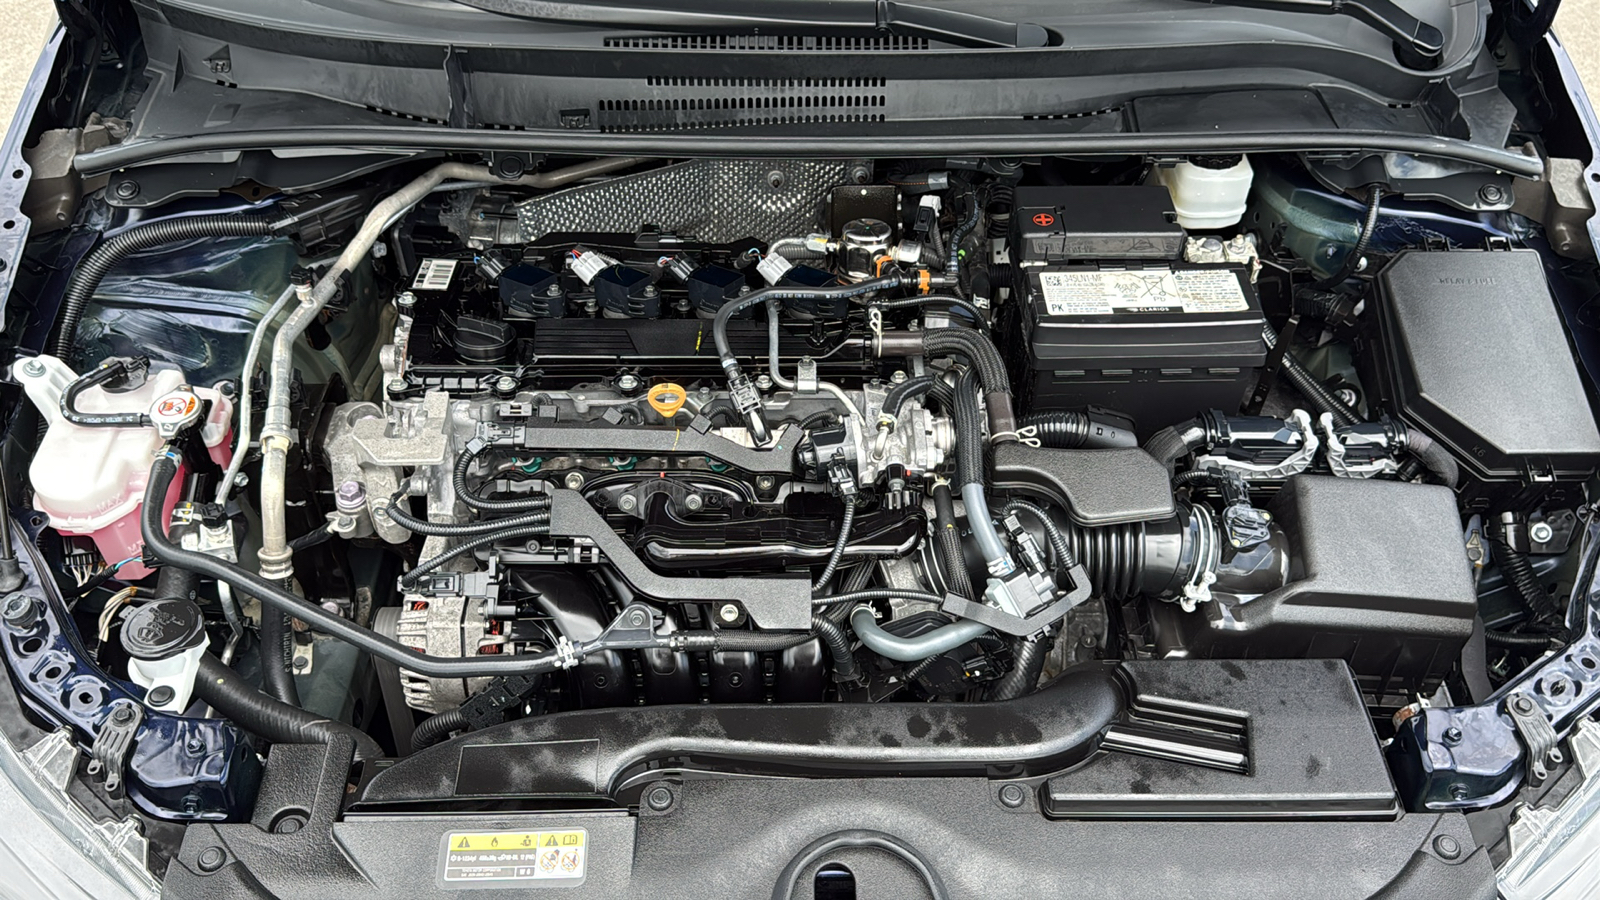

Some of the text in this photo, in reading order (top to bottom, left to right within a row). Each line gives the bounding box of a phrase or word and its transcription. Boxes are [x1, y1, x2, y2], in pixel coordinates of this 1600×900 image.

[1051, 304, 1064, 312] PK
[1471, 445, 1486, 457] K6
[96, 492, 124, 514] MAX
